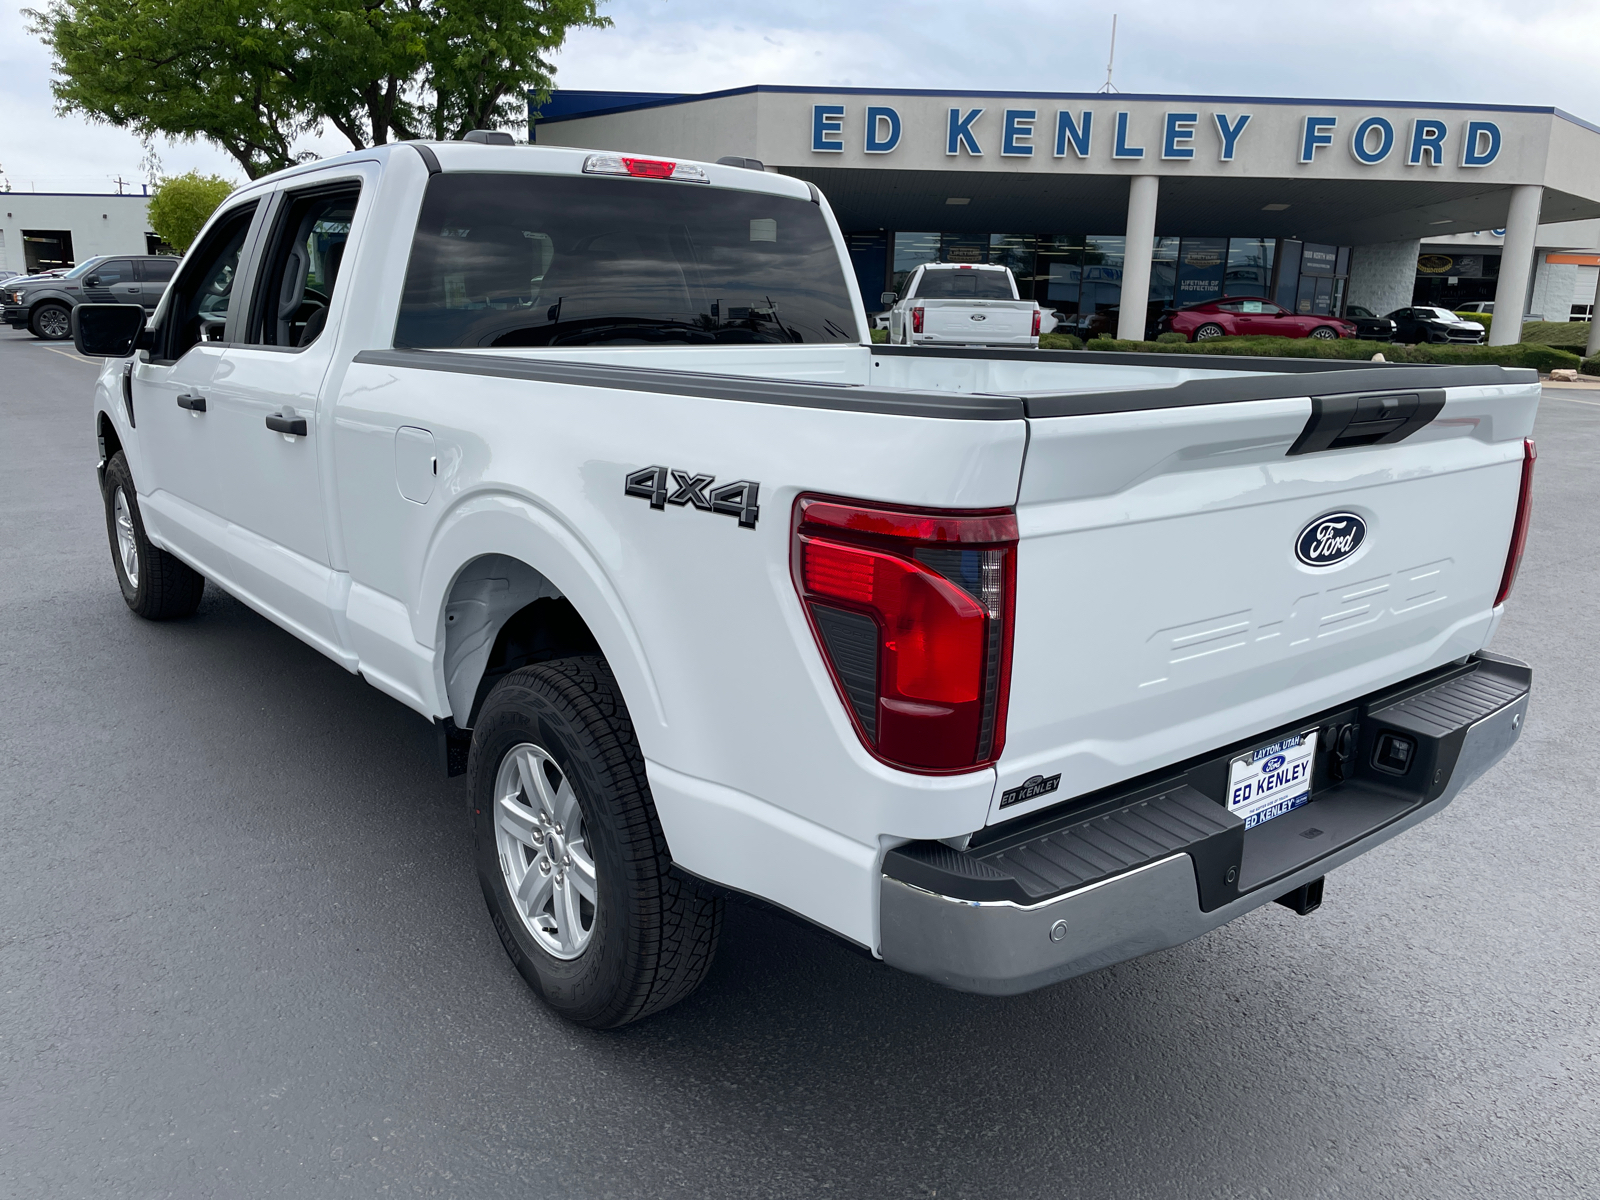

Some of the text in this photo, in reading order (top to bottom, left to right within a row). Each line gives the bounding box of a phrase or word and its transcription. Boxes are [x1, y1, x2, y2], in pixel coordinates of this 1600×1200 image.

[811, 104, 1503, 168] ED KENLEY FORD
[1309, 520, 1357, 559] Ford
[1138, 556, 1455, 688] F-150
[1253, 735, 1300, 761] LAYTON, UTAH
[1265, 757, 1283, 771] Ford
[1001, 778, 1060, 805] ED KENLEY
[1233, 760, 1309, 805] ED KENLEY
[1245, 814, 1258, 830] ED
[1259, 799, 1294, 823] KENLEY
